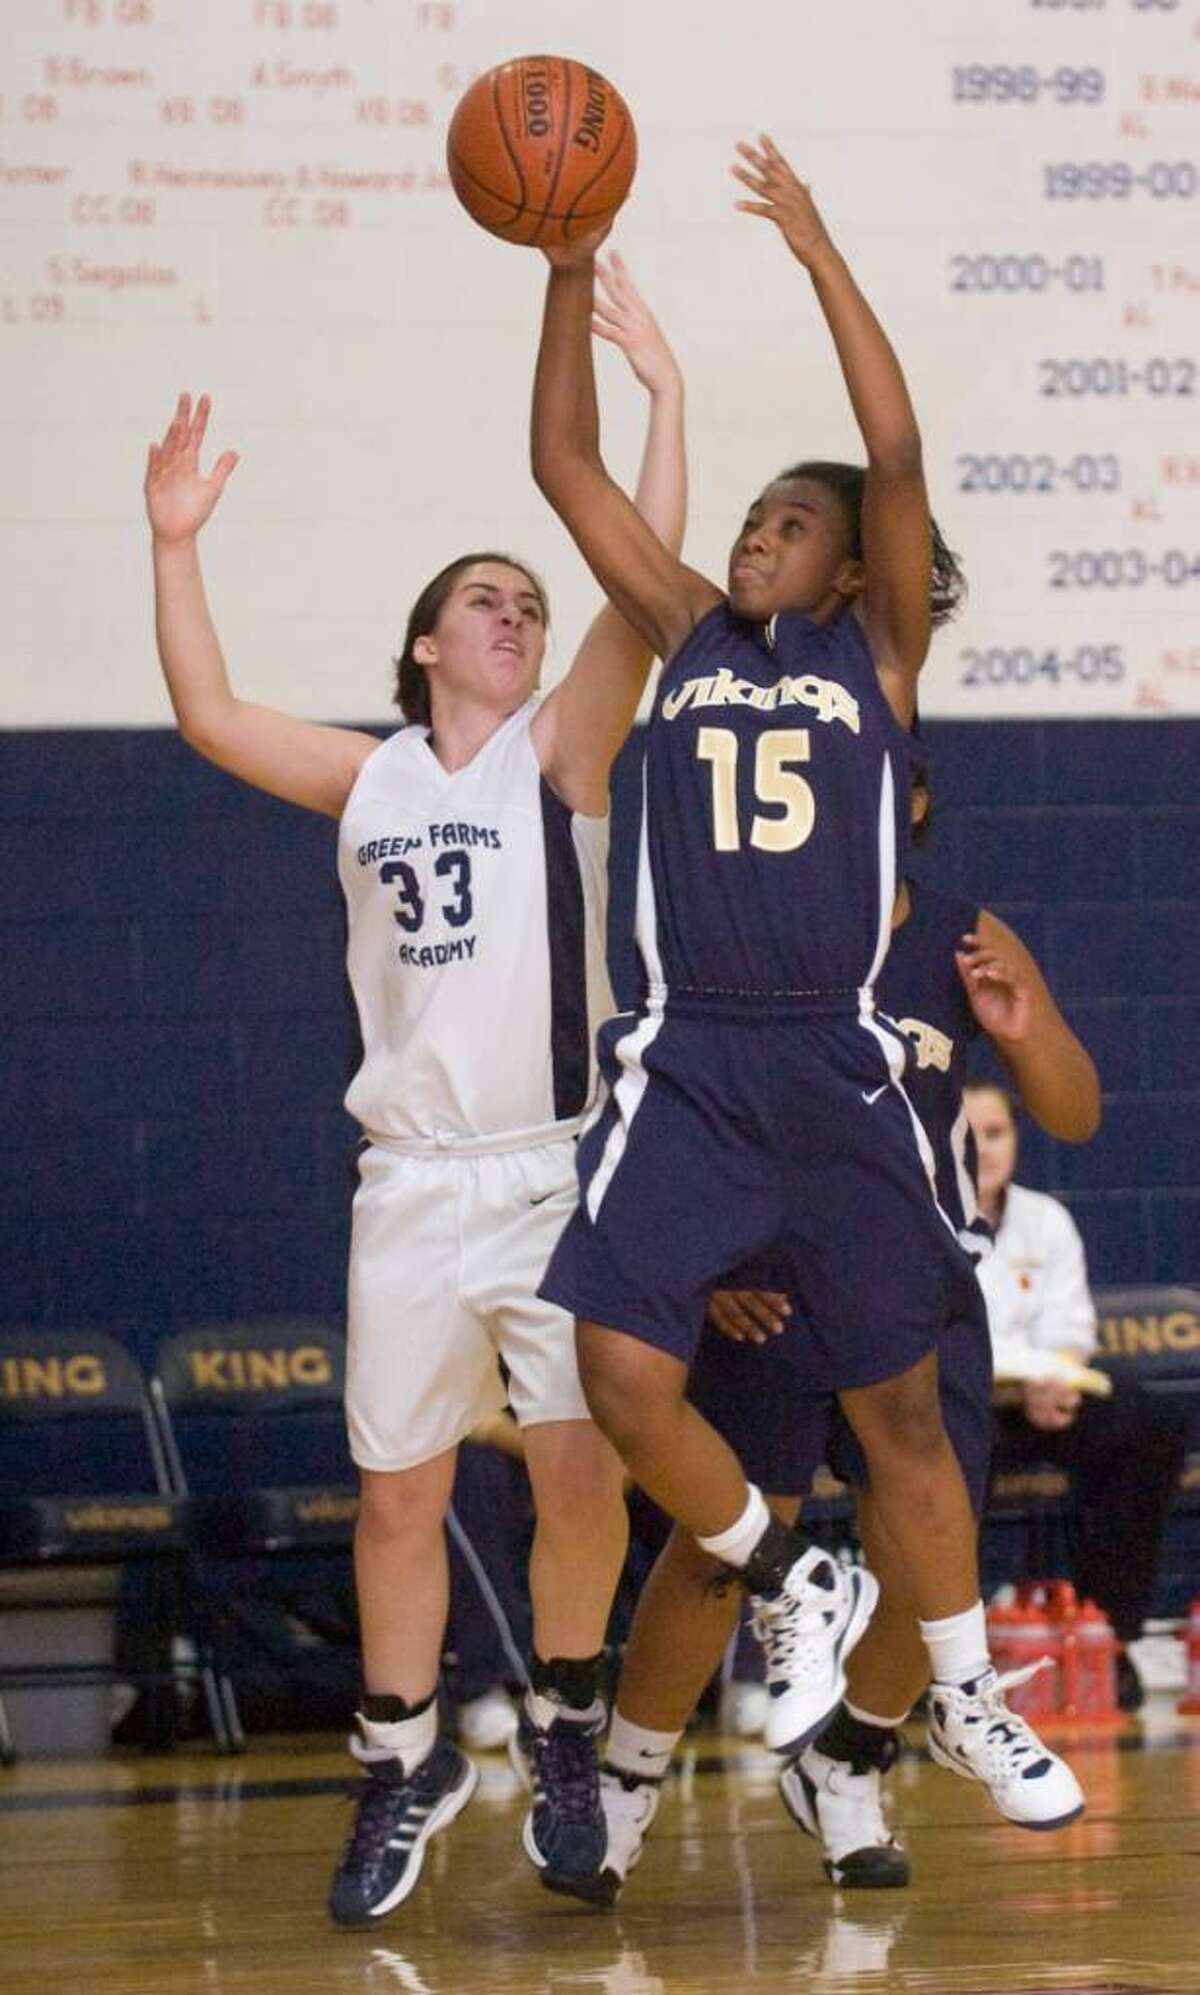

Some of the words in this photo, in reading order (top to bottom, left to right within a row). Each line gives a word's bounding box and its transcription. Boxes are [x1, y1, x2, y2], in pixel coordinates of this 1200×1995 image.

[952, 65, 1105, 104] 1998-99
[1044, 162, 1198, 200] 1999-00
[950, 254, 1105, 292] 2000-01
[1038, 359, 1198, 398] 2001-02
[957, 454, 1121, 492] 2002-03
[960, 646, 1125, 686] 2004-05
[697, 727, 816, 853] 15
[428, 822, 502, 849] FARMS
[379, 850, 473, 933] 33
[190, 1346, 332, 1391] KING
